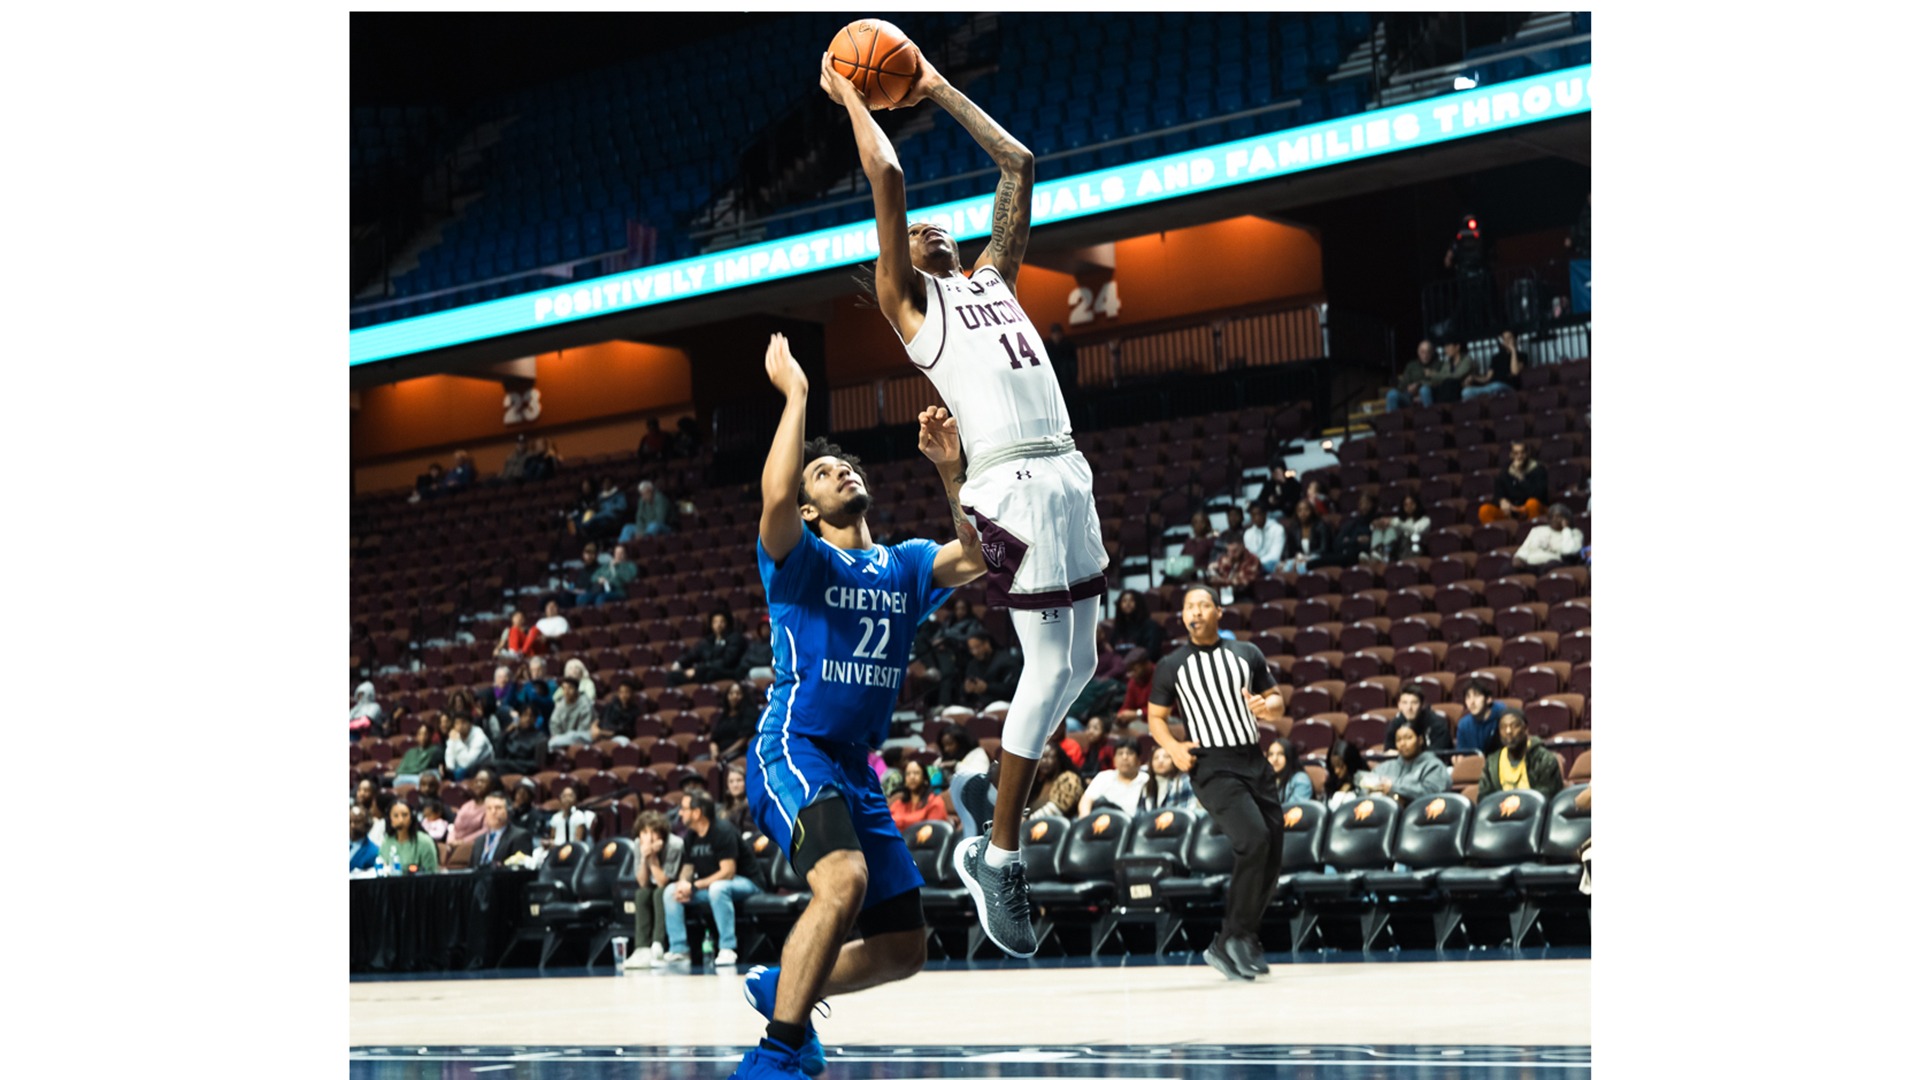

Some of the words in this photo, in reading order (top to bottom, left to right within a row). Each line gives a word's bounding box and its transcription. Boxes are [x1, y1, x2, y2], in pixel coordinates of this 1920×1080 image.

[535, 264, 706, 322] POSITIVELY
[1136, 158, 1215, 196] AND
[1225, 114, 1420, 178] FAMILIES
[1433, 77, 1592, 133] THROU
[1067, 280, 1122, 325] 24
[999, 332, 1041, 370] 14
[503, 388, 542, 425] 23
[824, 585, 907, 614] CHEYNEY
[852, 616, 891, 660] 22
[821, 658, 902, 689] UNIVERSIT
